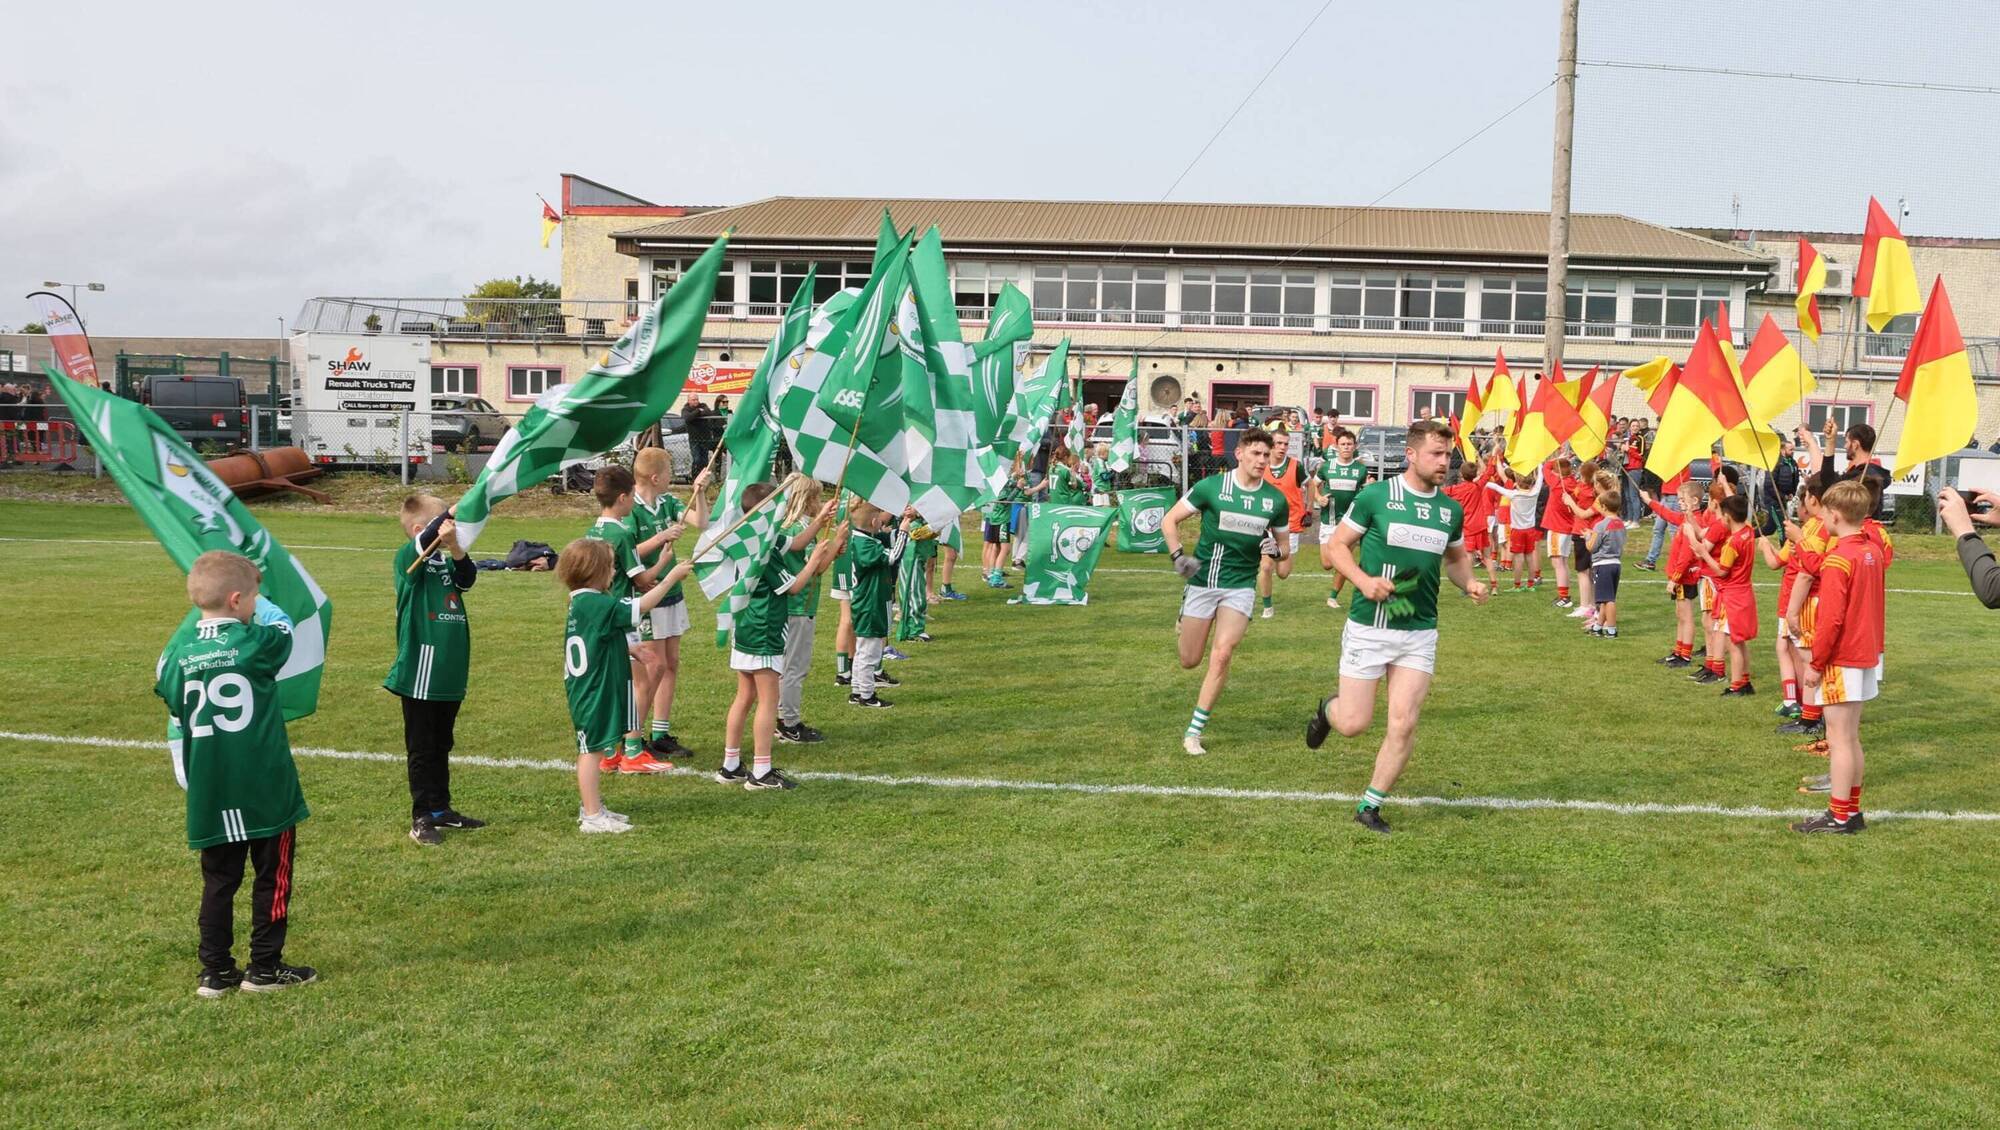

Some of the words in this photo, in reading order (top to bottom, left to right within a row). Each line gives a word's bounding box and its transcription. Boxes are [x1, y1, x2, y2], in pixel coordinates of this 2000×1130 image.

[328, 360, 371, 371] SHAW
[393, 372, 413, 380] NEW
[328, 379, 361, 388] Renault
[361, 380, 389, 389] Trucks
[389, 381, 412, 390] Trafic
[340, 391, 354, 399] Low
[357, 391, 393, 400] Platform
[1049, 475, 1059, 490] 17
[1243, 499, 1252, 510] 11
[1386, 501, 1407, 512] GAA
[1416, 507, 1430, 520] 13
[1411, 533, 1447, 548] crean
[564, 635, 588, 680] 0
[183, 672, 254, 738] 29
